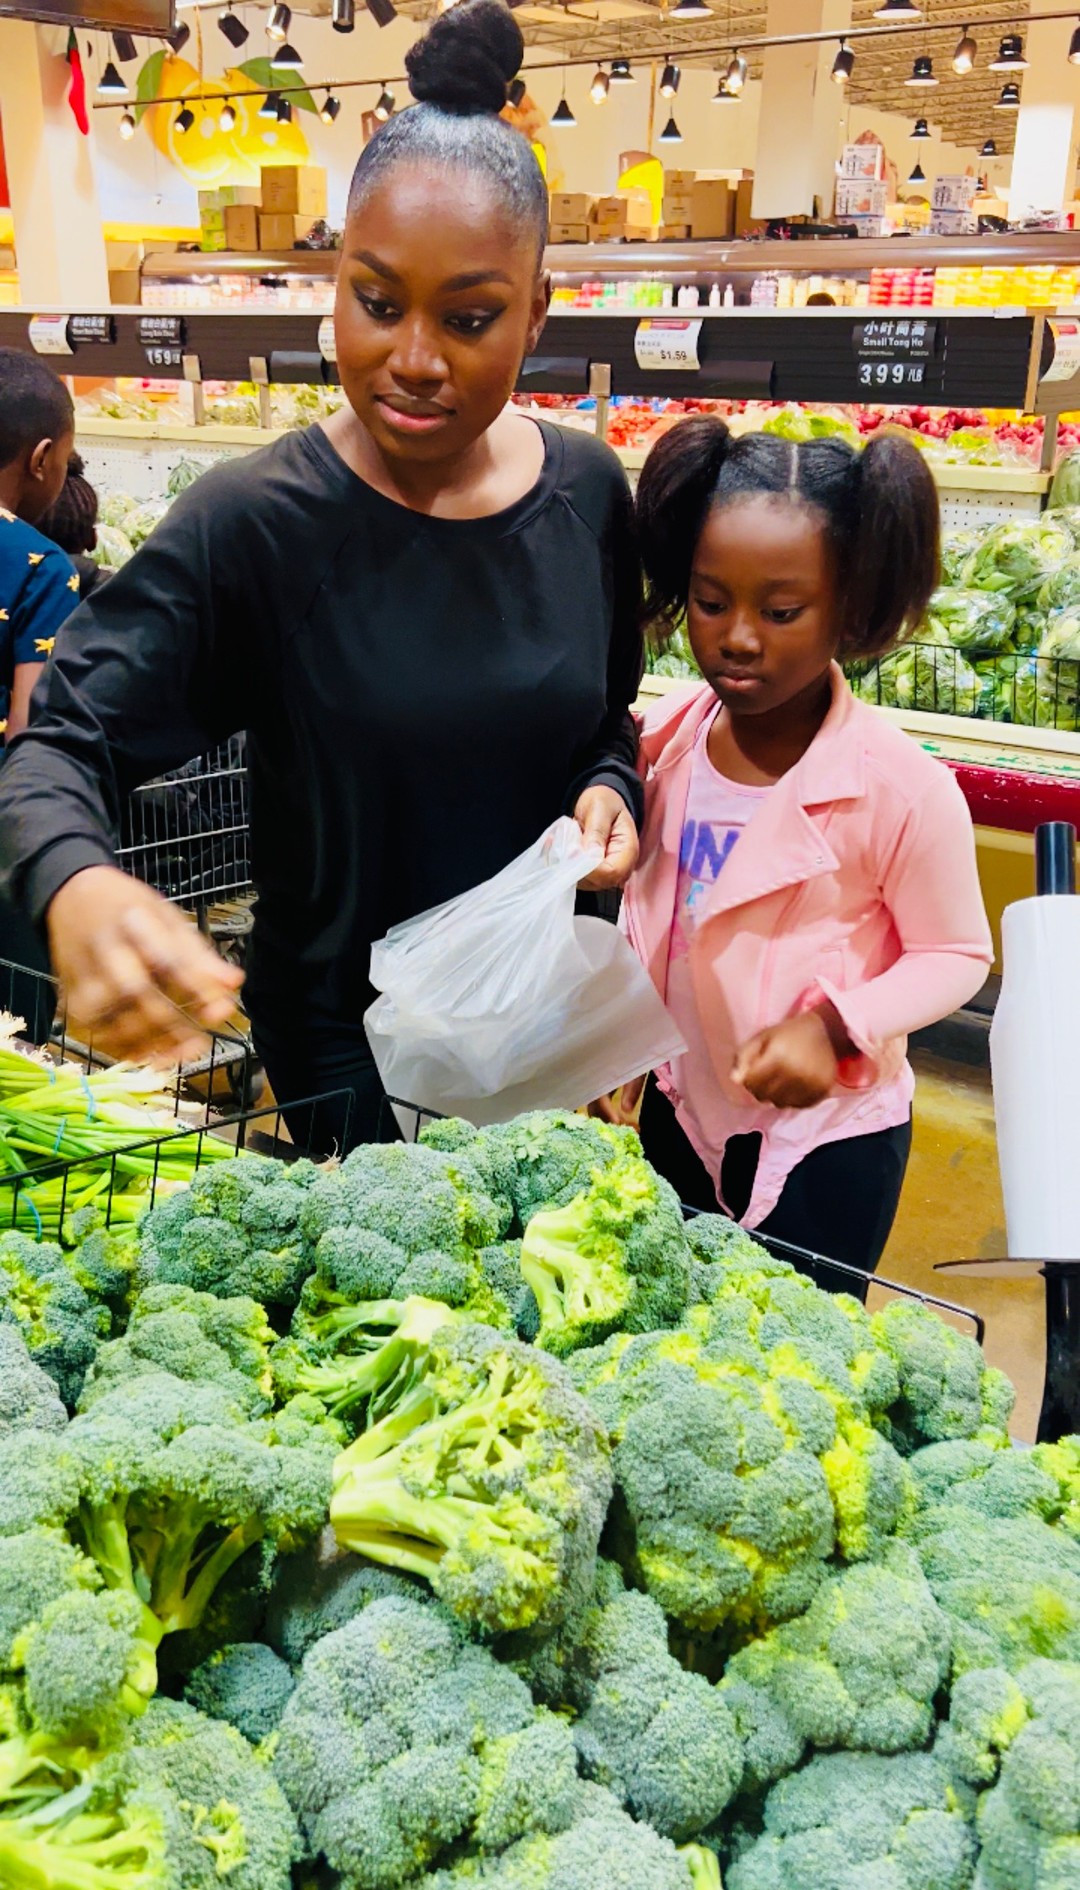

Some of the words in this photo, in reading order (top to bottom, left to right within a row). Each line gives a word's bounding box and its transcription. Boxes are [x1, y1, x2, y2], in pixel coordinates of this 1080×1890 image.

[863, 337, 887, 347] Small
[888, 337, 910, 348] Tong
[911, 338, 924, 347] Ho
[660, 349, 688, 361] $1.59
